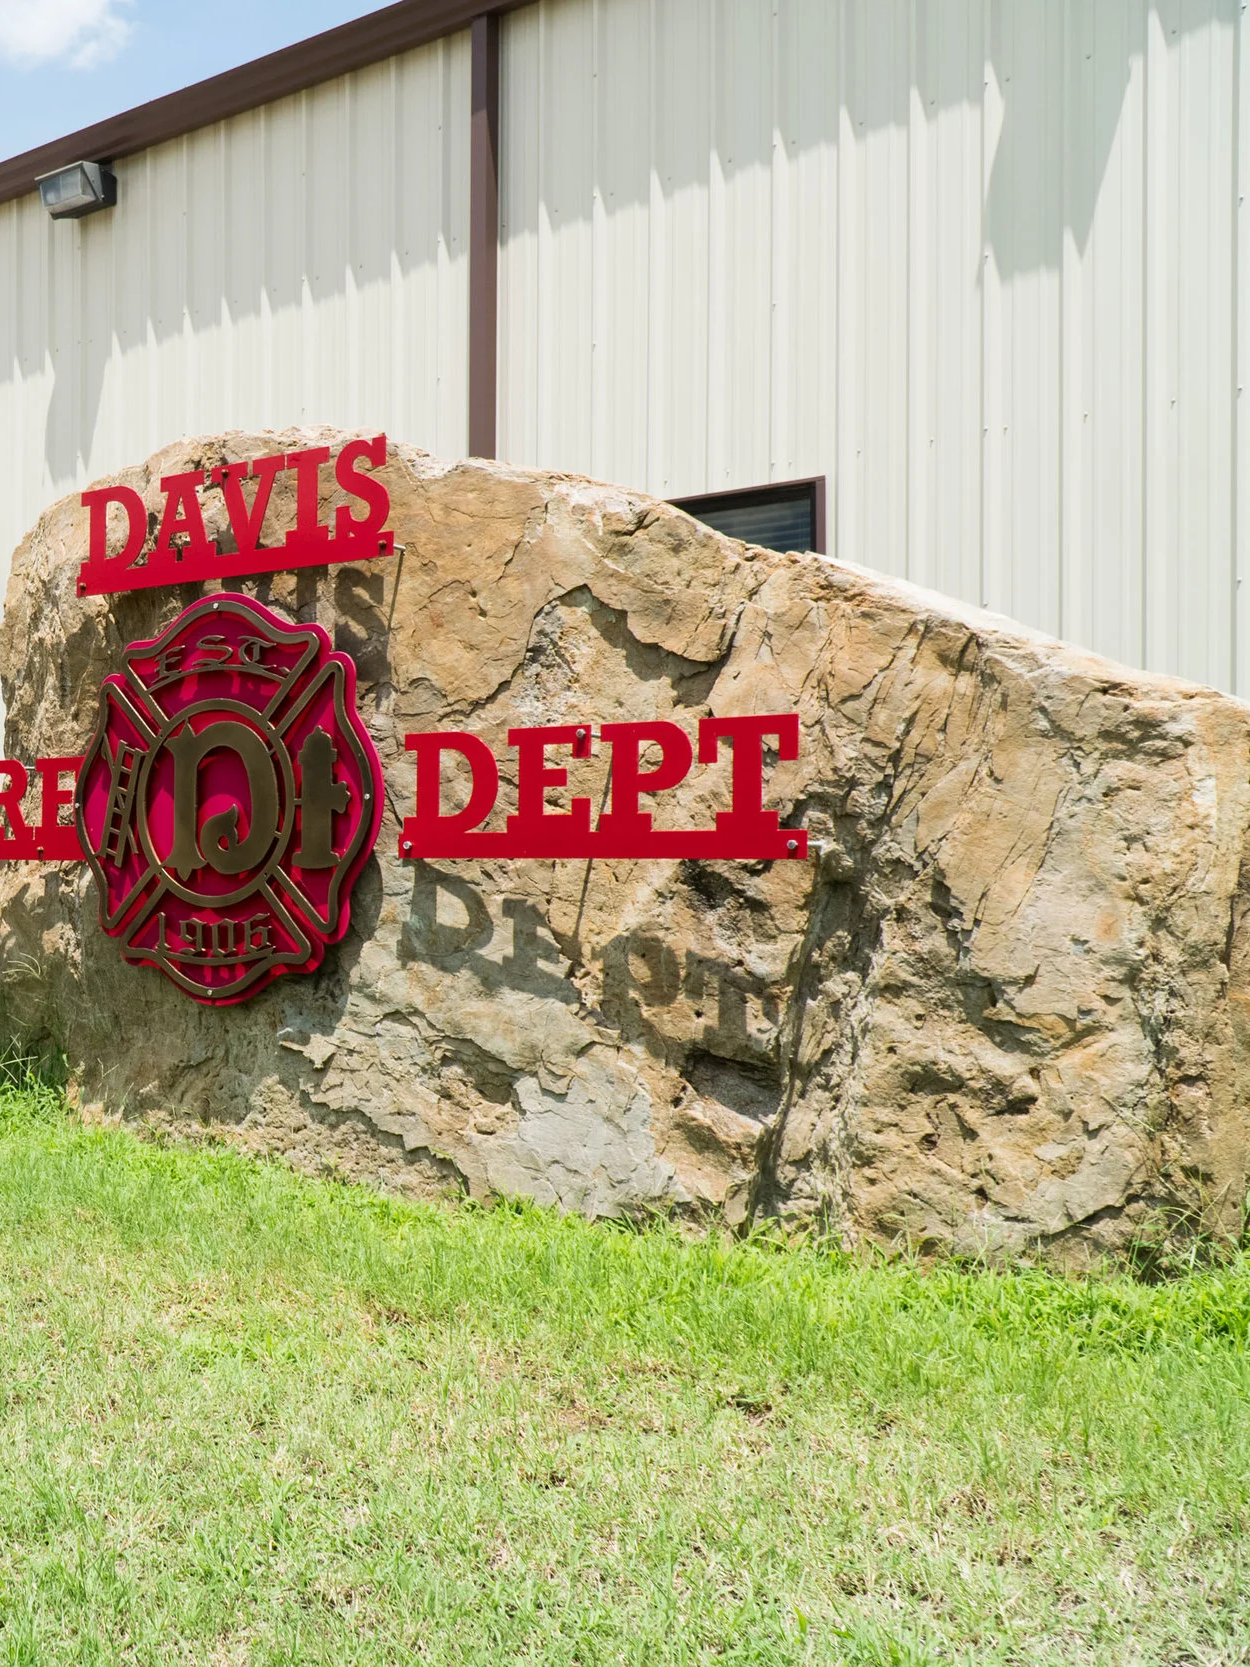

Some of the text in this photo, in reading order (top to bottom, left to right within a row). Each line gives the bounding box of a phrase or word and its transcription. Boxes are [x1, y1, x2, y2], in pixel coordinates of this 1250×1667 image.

[80, 435, 391, 576] DAVIS
[403, 713, 799, 833] DEPT
[154, 911, 276, 958] 1906
